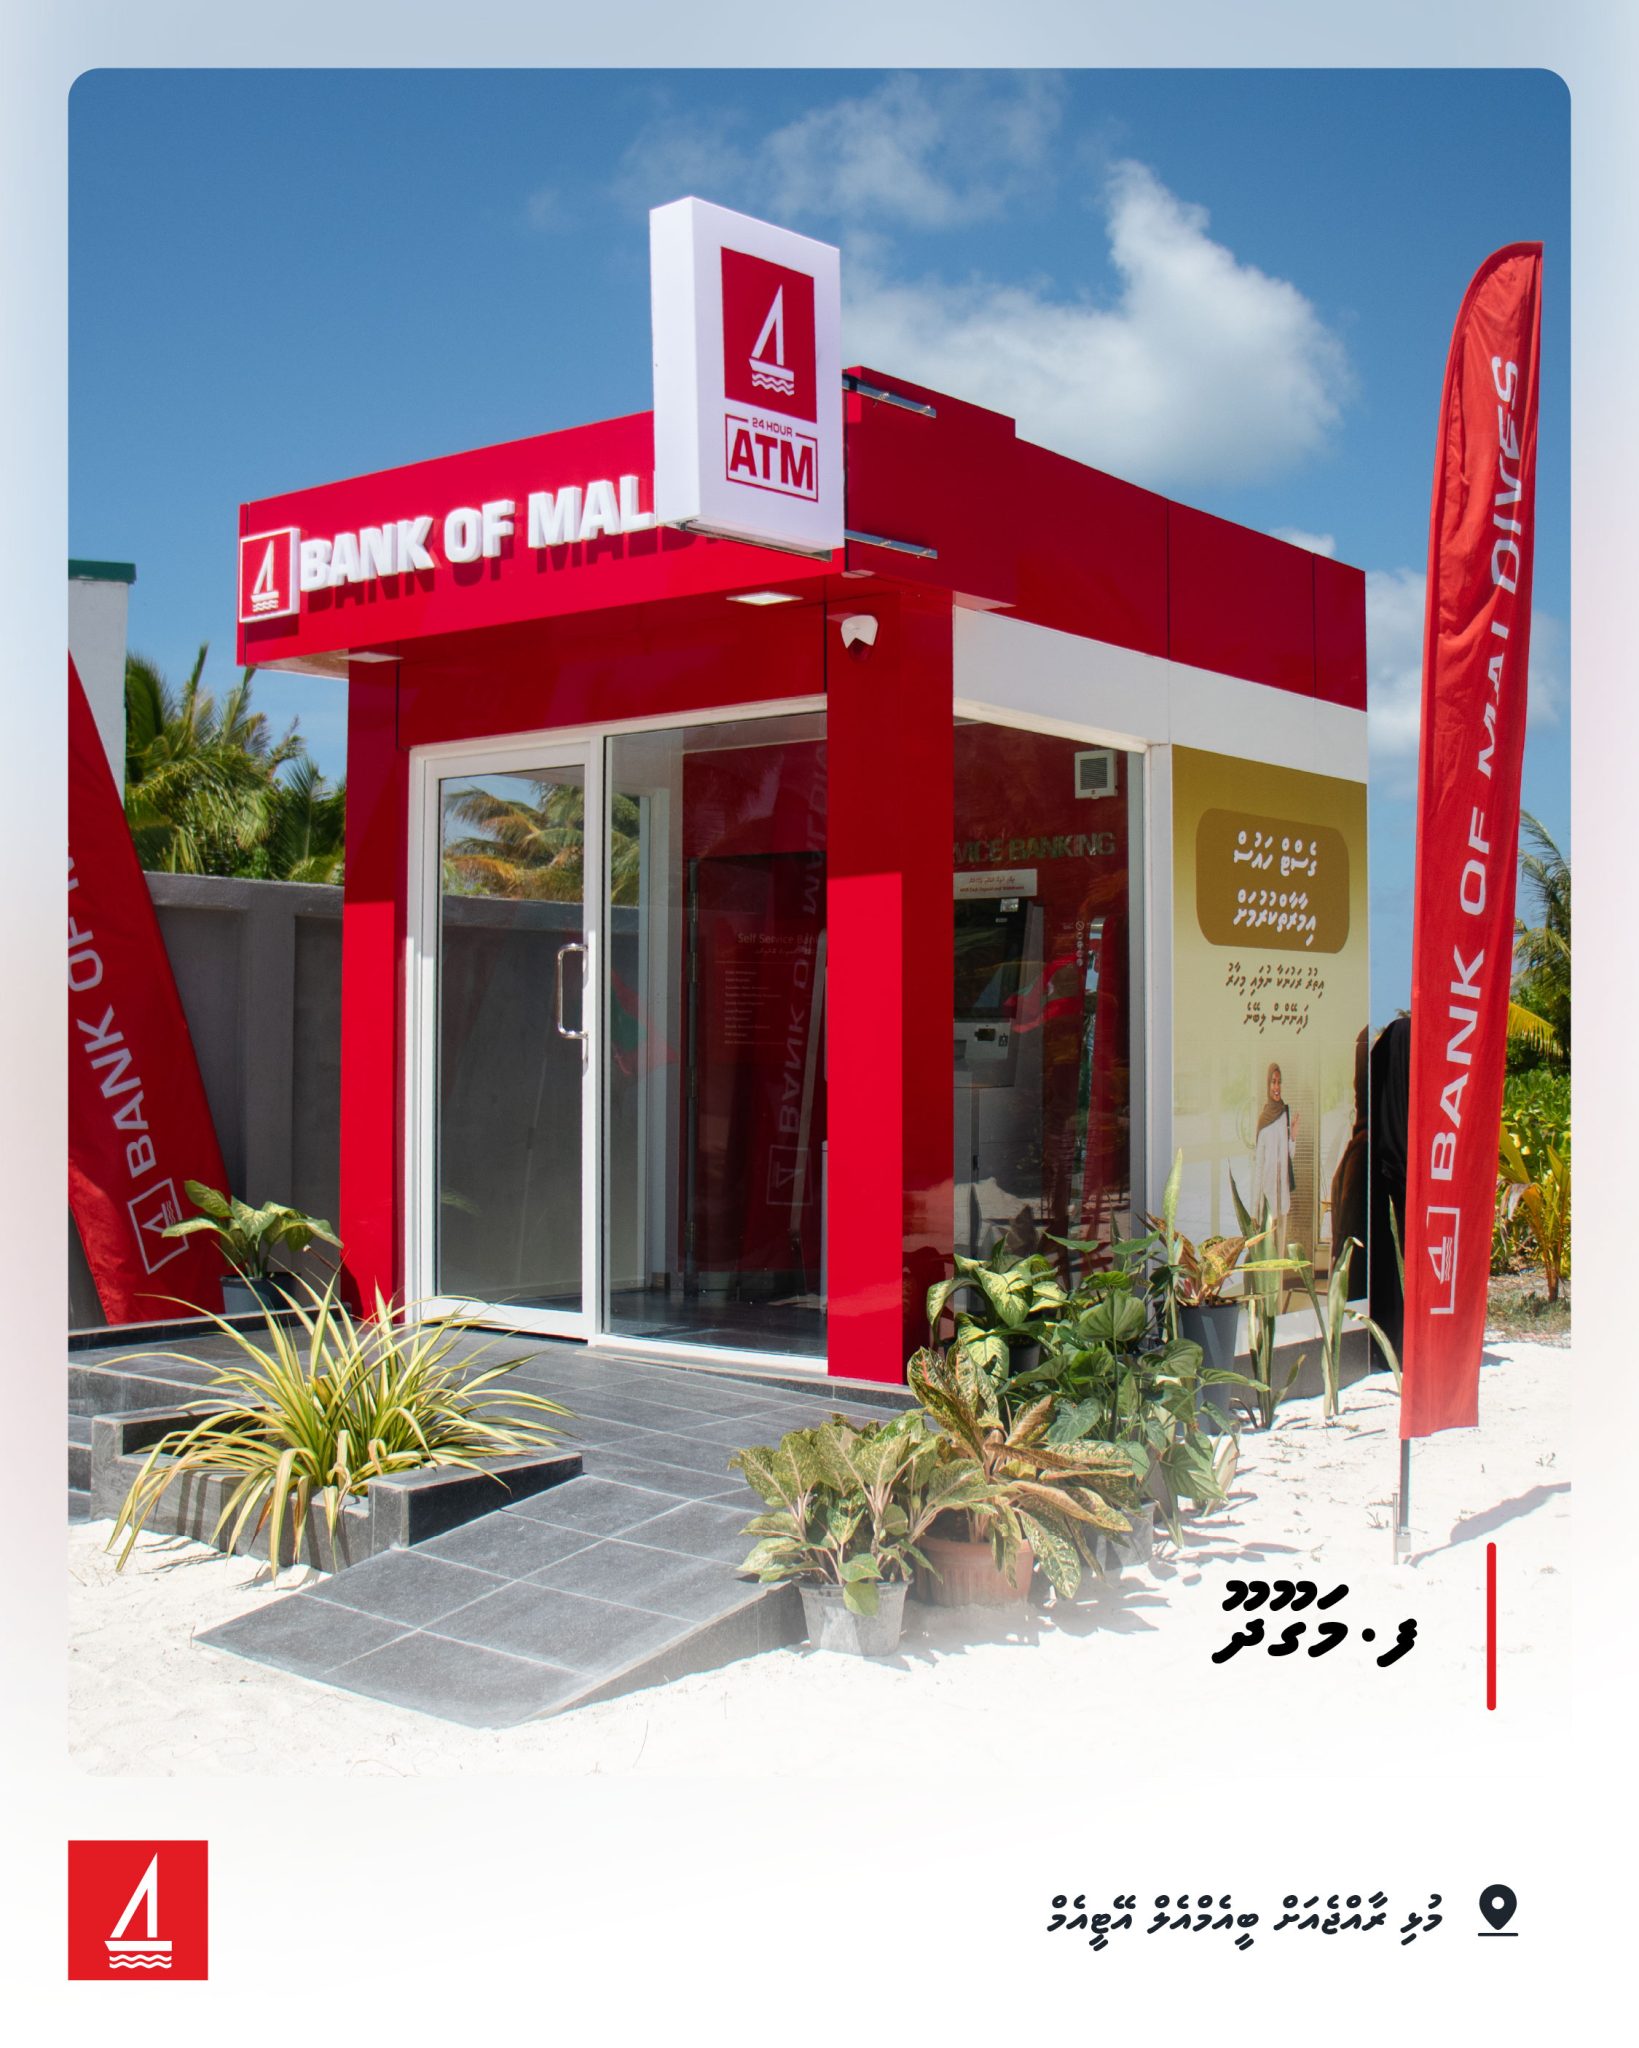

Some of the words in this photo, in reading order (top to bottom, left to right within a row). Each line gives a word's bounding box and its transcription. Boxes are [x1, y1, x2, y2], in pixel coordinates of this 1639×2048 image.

[752, 417, 765, 430] 24
[766, 421, 793, 438] HOUR
[730, 428, 813, 491] ATM
[300, 515, 435, 592] BANK
[444, 499, 516, 564] OF
[528, 475, 657, 549] MAL
[953, 838, 1003, 863] VICE
[1009, 832, 1116, 861] BANKING
[1233, 830, 1274, 870] ހައުސް
[1280, 836, 1318, 877] ގެސްޓް
[737, 932, 757, 944] Self
[759, 933, 793, 944] Service
[1431, 945, 1485, 1181] BANK
[1459, 806, 1490, 916] OF
[77, 1005, 158, 1178] BANK
